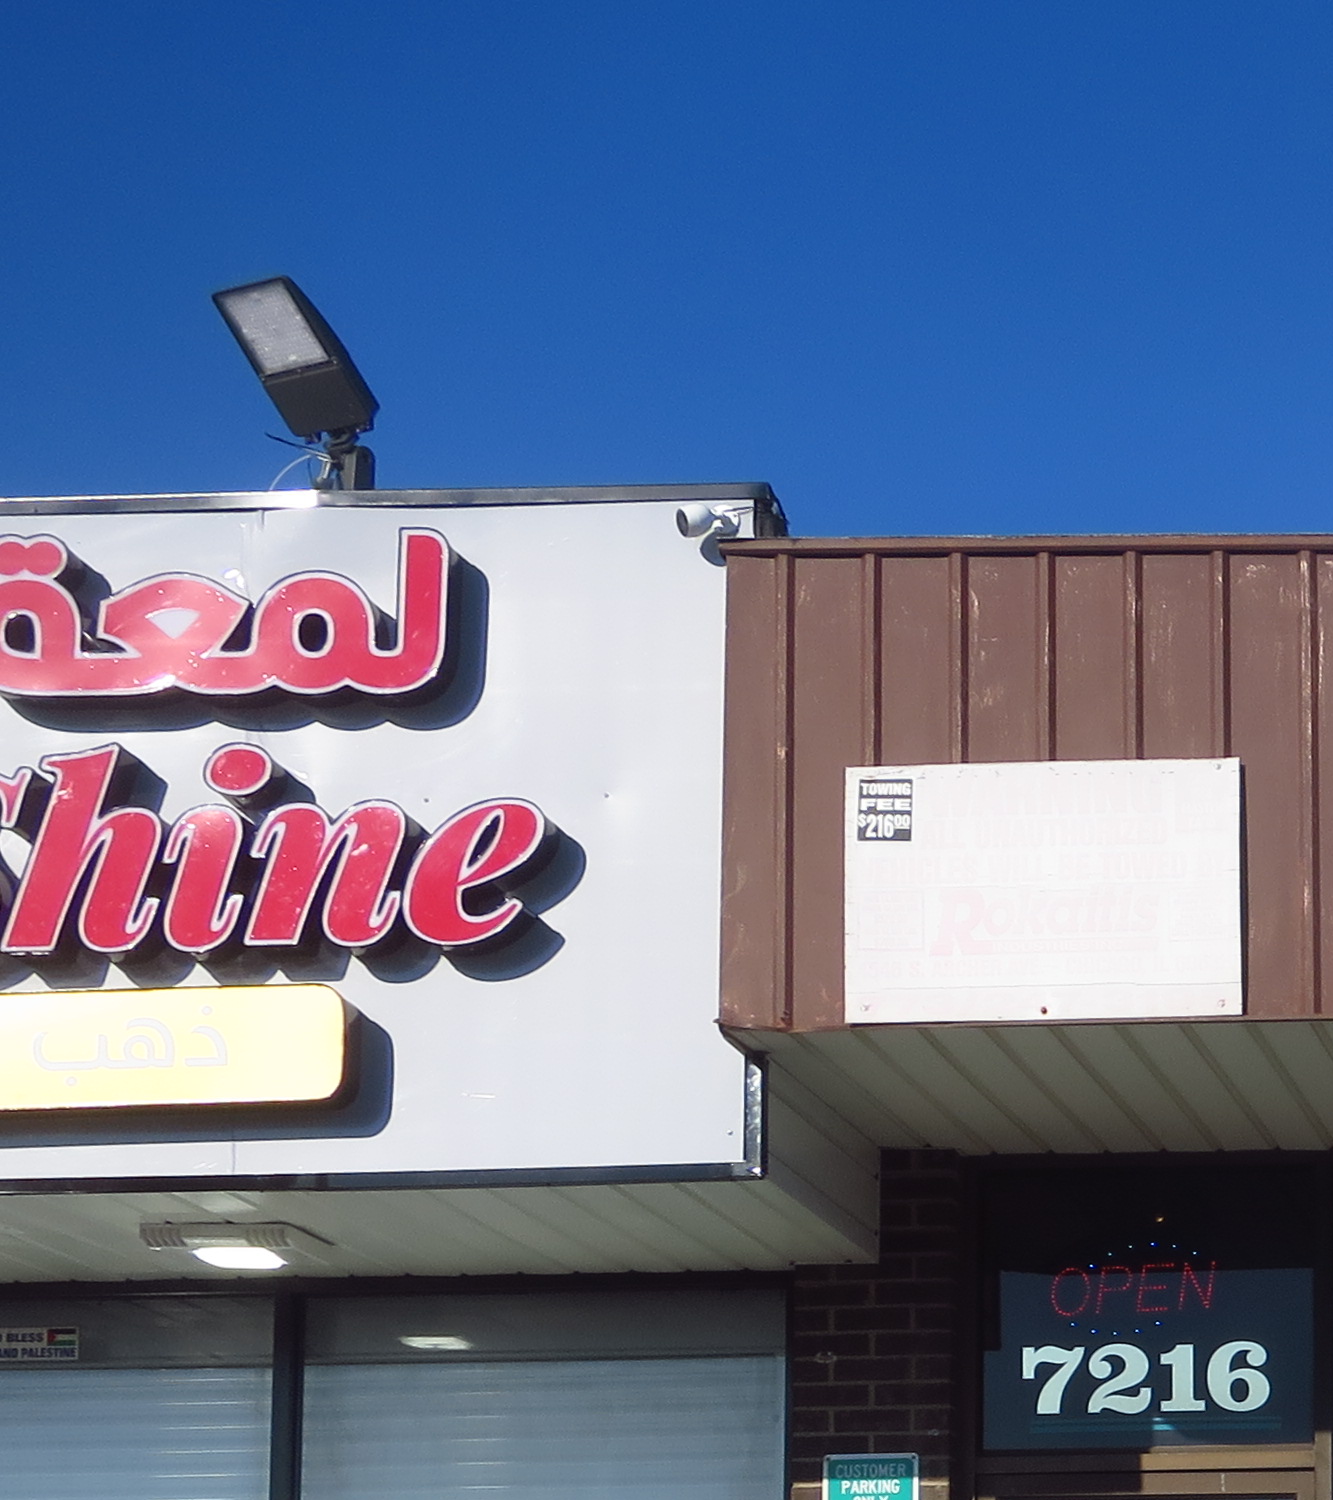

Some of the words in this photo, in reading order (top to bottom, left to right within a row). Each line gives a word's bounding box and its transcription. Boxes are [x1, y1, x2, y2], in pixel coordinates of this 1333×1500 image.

[860, 783, 911, 795] TOWING
[860, 798, 911, 811] FEE
[0, 742, 546, 953] hine
[32, 1005, 229, 1087] ذهب
[1051, 1261, 1217, 1317] OPEN
[6, 1333, 44, 1343] BLESS
[21, 1348, 77, 1358] PALESTINE
[1021, 1340, 1271, 1415] 7216
[835, 1463, 906, 1478] CUSTOMER
[841, 1479, 900, 1494] PARKING
